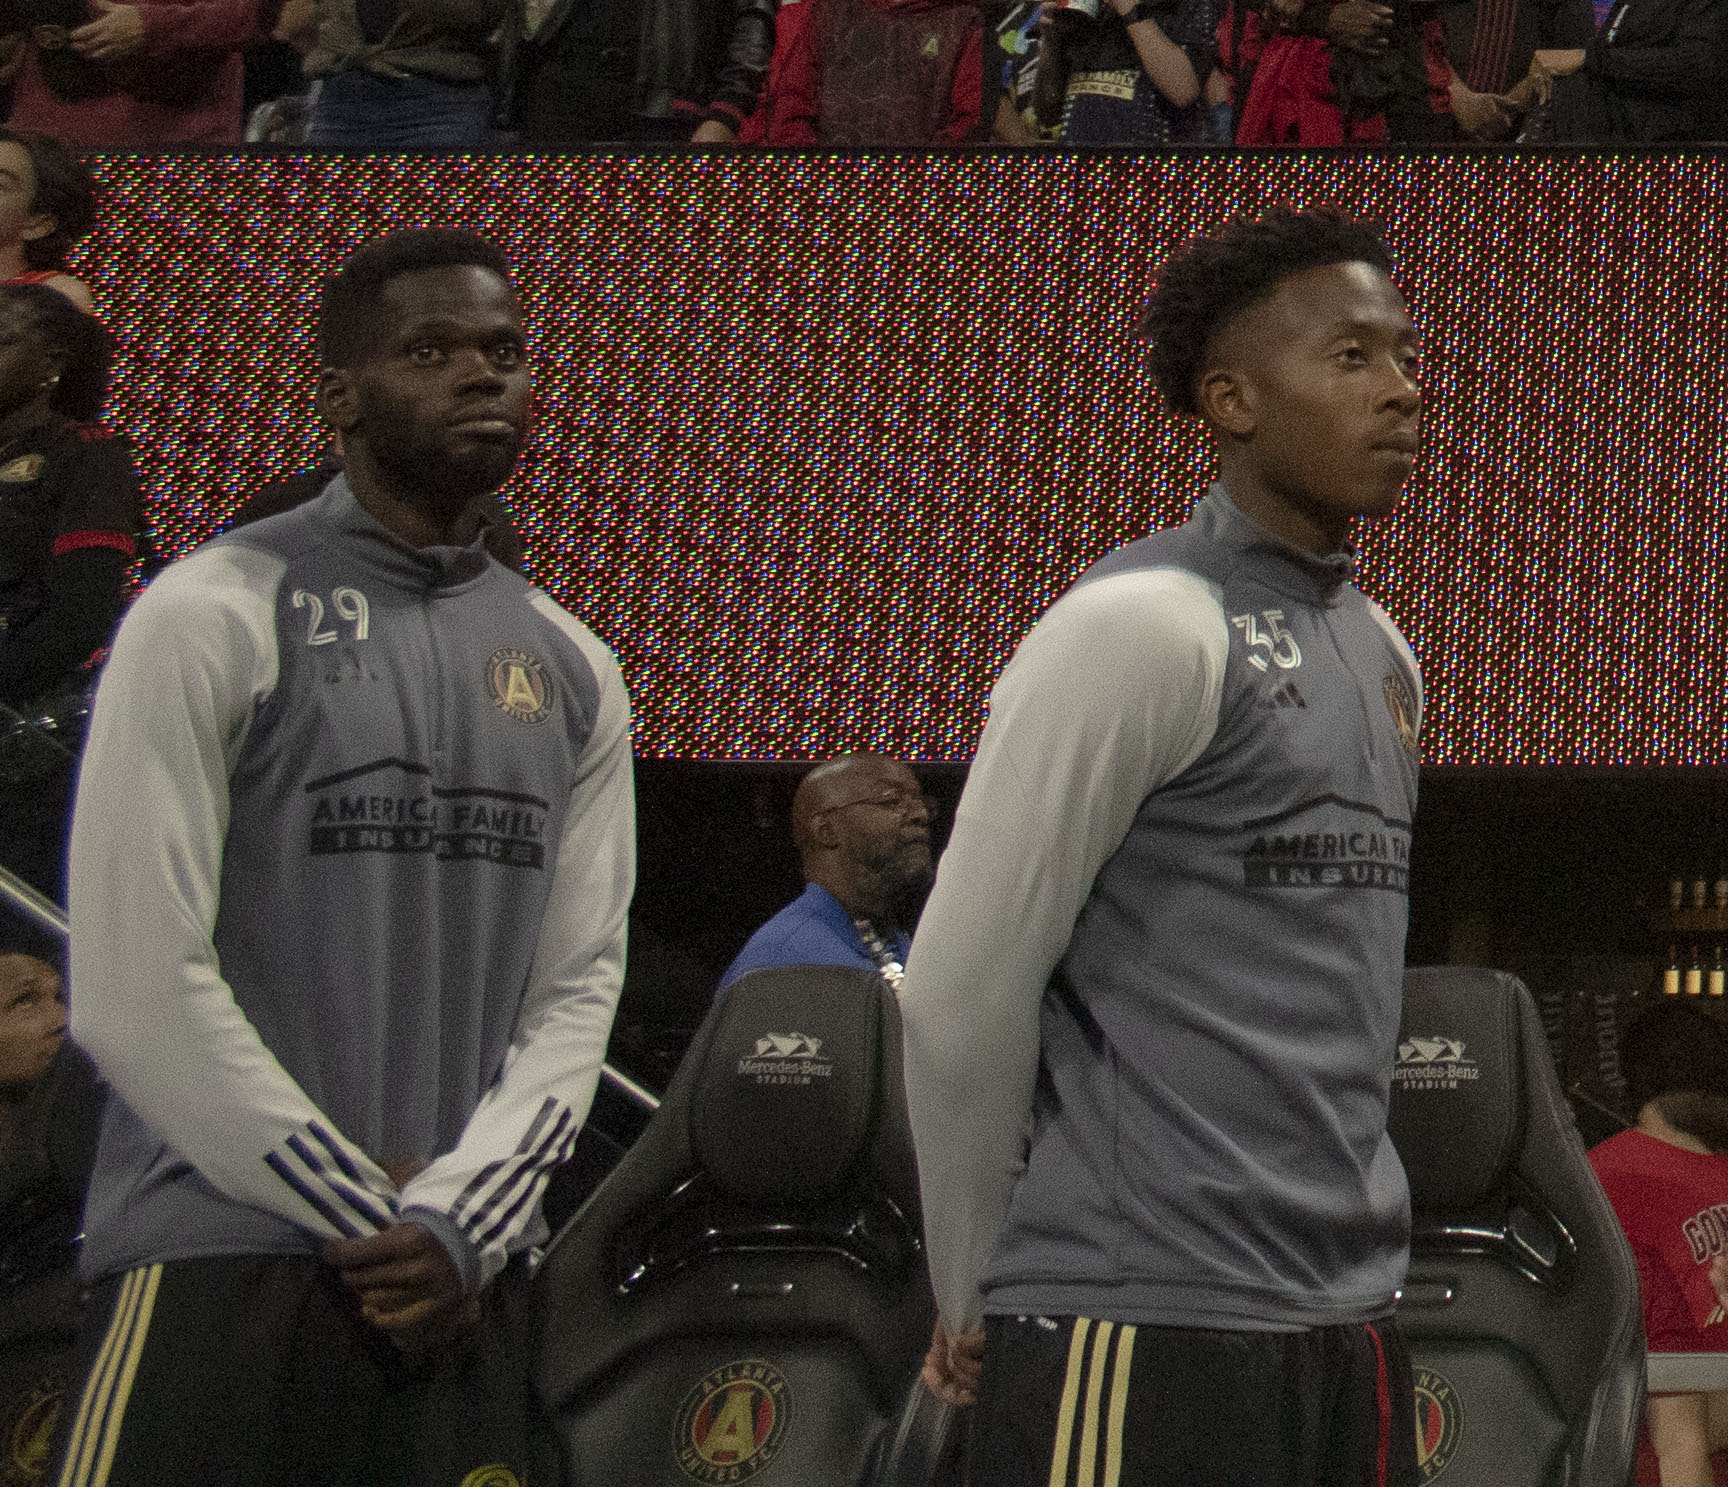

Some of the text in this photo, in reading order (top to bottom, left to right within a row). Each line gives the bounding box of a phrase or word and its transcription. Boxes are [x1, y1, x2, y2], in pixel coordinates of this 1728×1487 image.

[293, 586, 370, 645] 29
[1231, 610, 1302, 672] 35
[738, 1060, 833, 1076] Mercedes-Benz
[1403, 1079, 1458, 1089] STADIUM
[703, 1364, 783, 1393] ATLANTA
